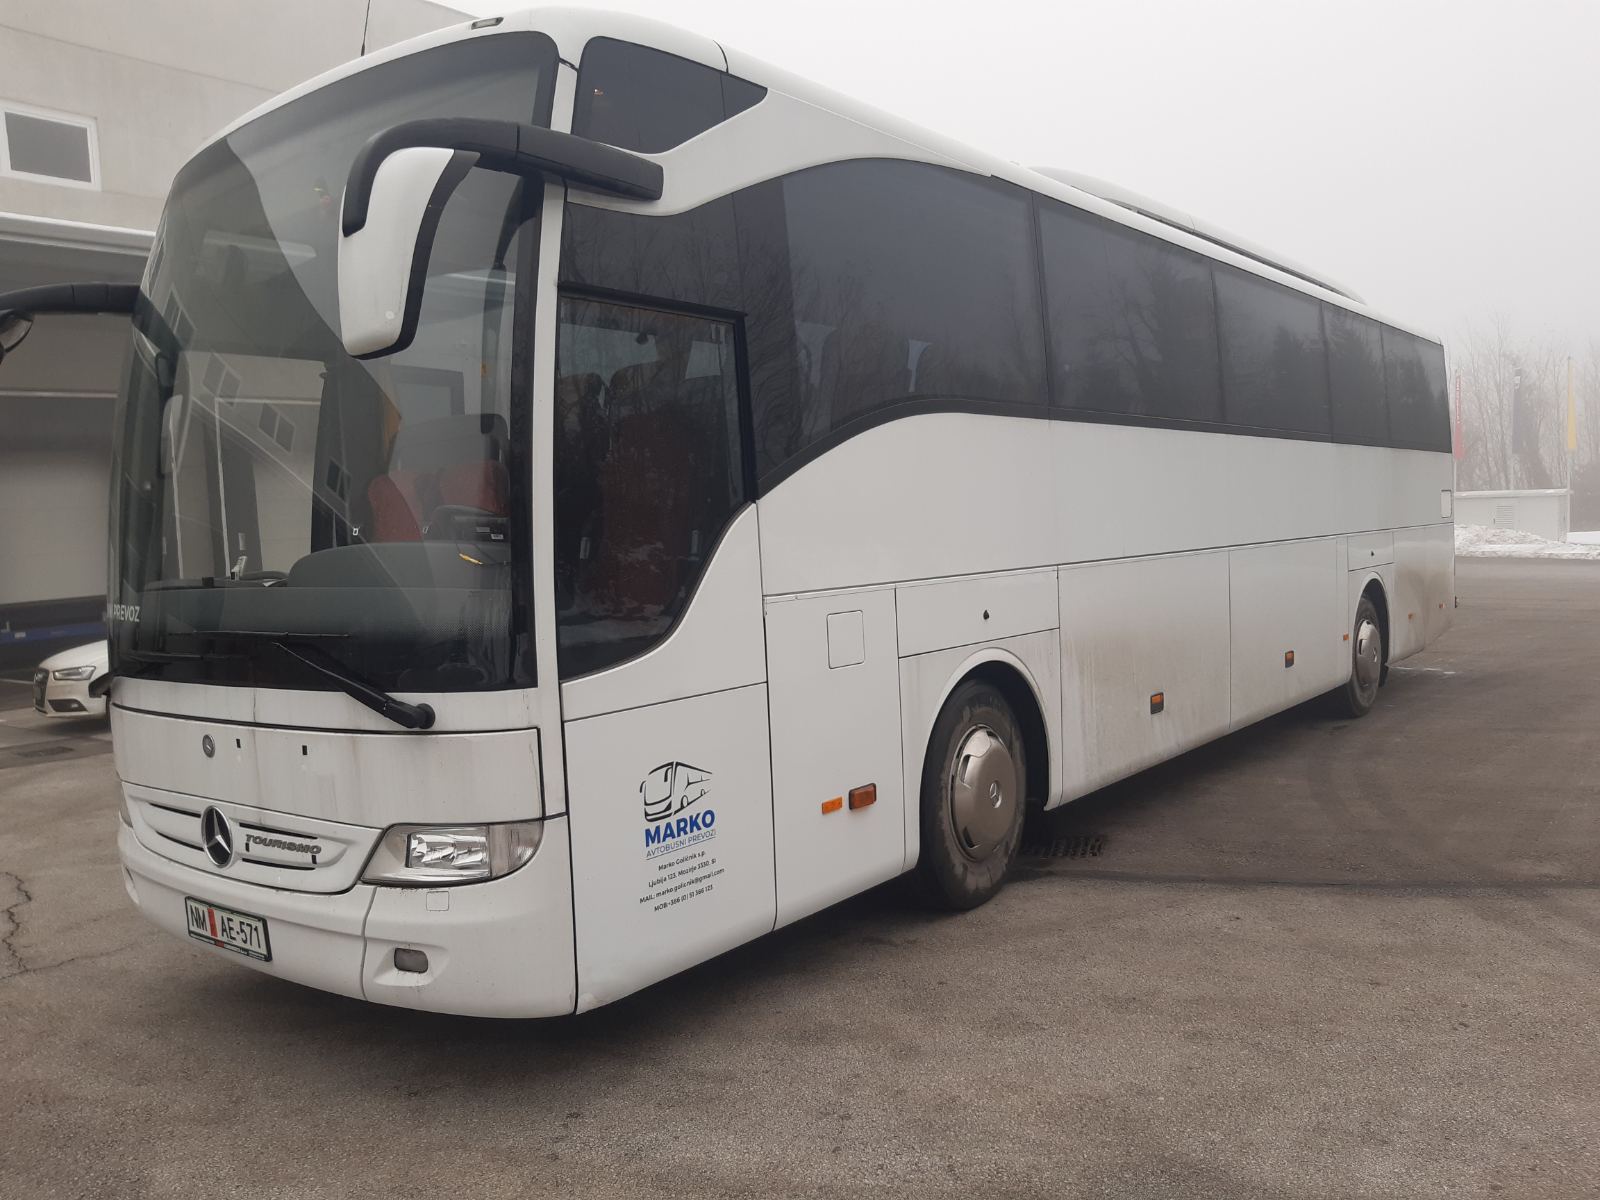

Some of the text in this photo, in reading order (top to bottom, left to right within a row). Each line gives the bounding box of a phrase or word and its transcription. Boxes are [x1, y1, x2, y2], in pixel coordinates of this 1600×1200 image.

[645, 809, 716, 848] MARKO
[246, 834, 321, 854] TOURISMO
[646, 829, 717, 857] AVTOBUSNI PREVOZI
[658, 861, 675, 871] Marko
[190, 904, 208, 932] NM
[221, 915, 261, 949] AE-571
